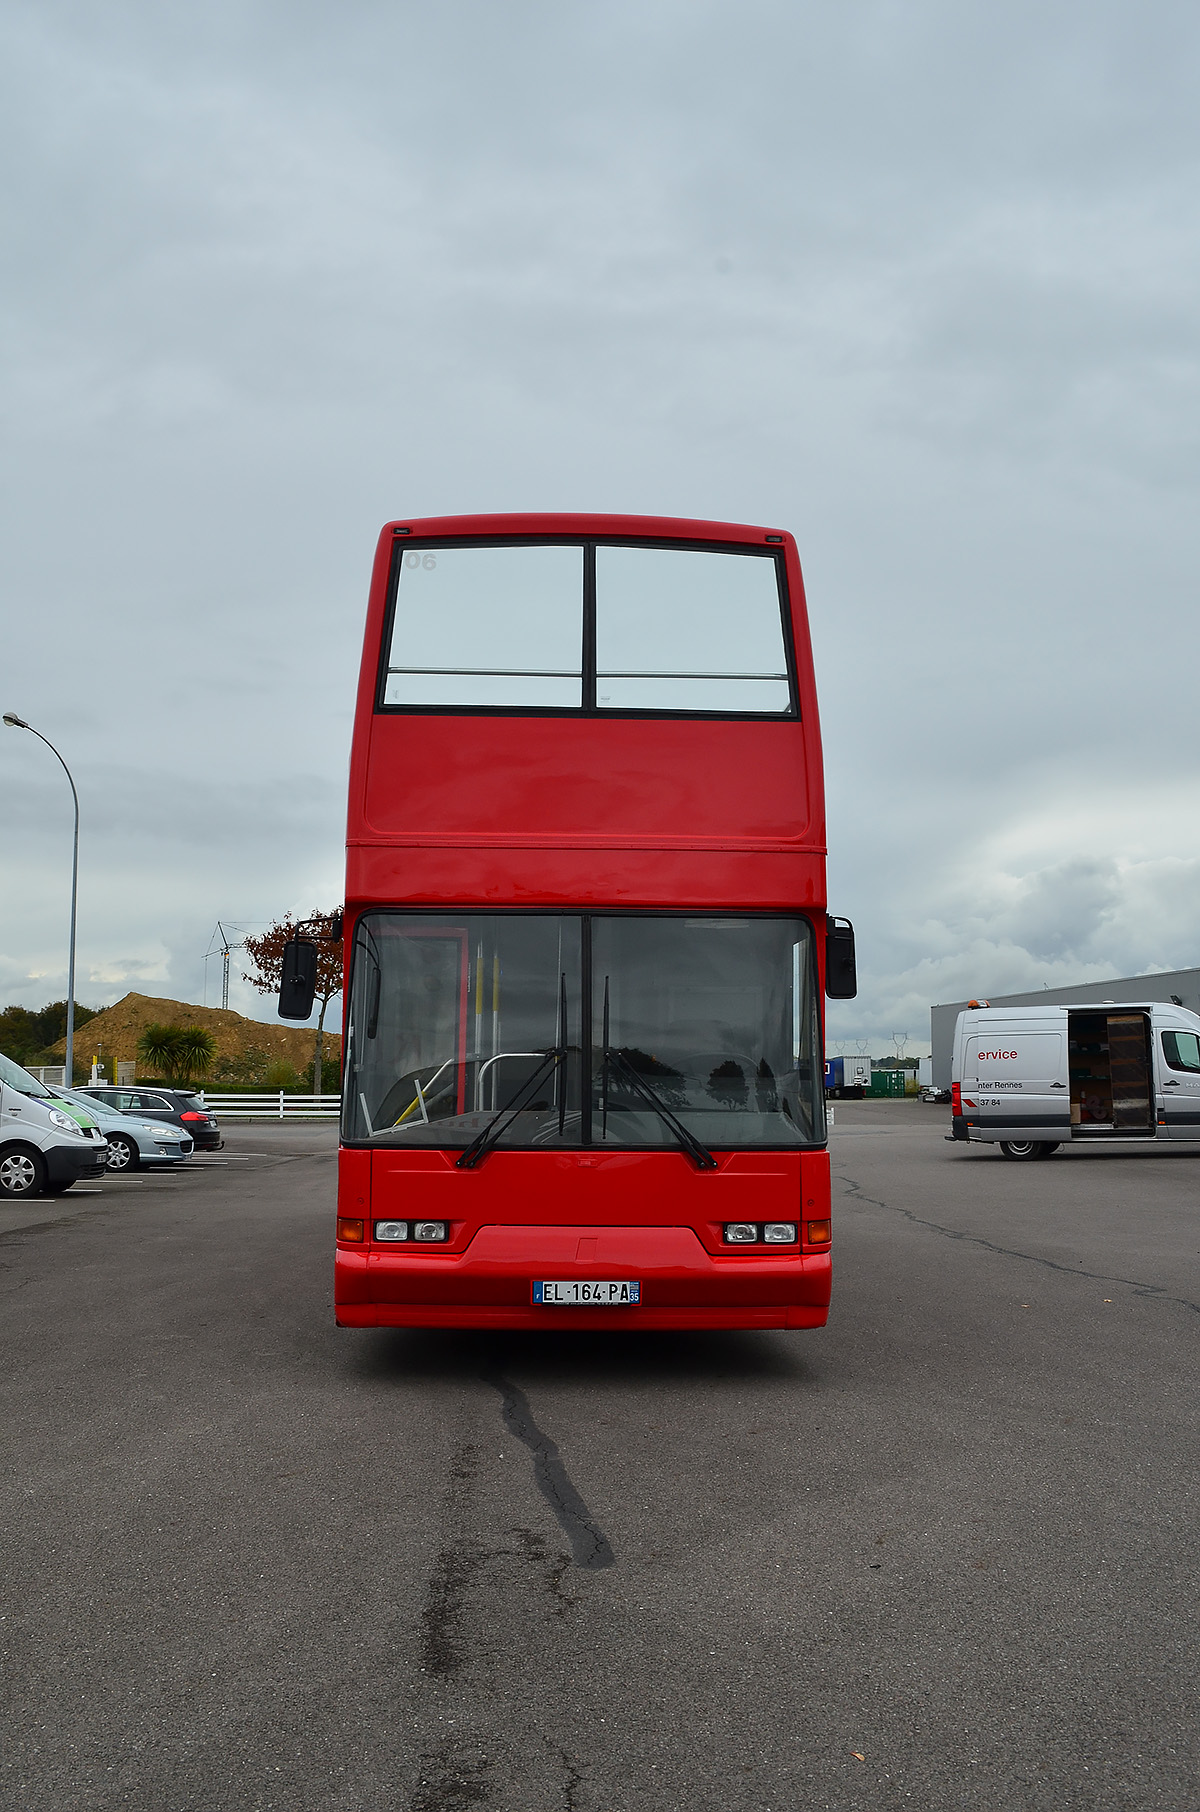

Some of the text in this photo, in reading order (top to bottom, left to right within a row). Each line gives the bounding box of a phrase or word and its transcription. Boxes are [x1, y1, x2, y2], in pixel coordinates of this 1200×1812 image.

[405, 552, 436, 571] 06
[978, 1049, 1018, 1060] ervice
[994, 1081, 1023, 1089] Rennes
[630, 1292, 639, 1301] 35
